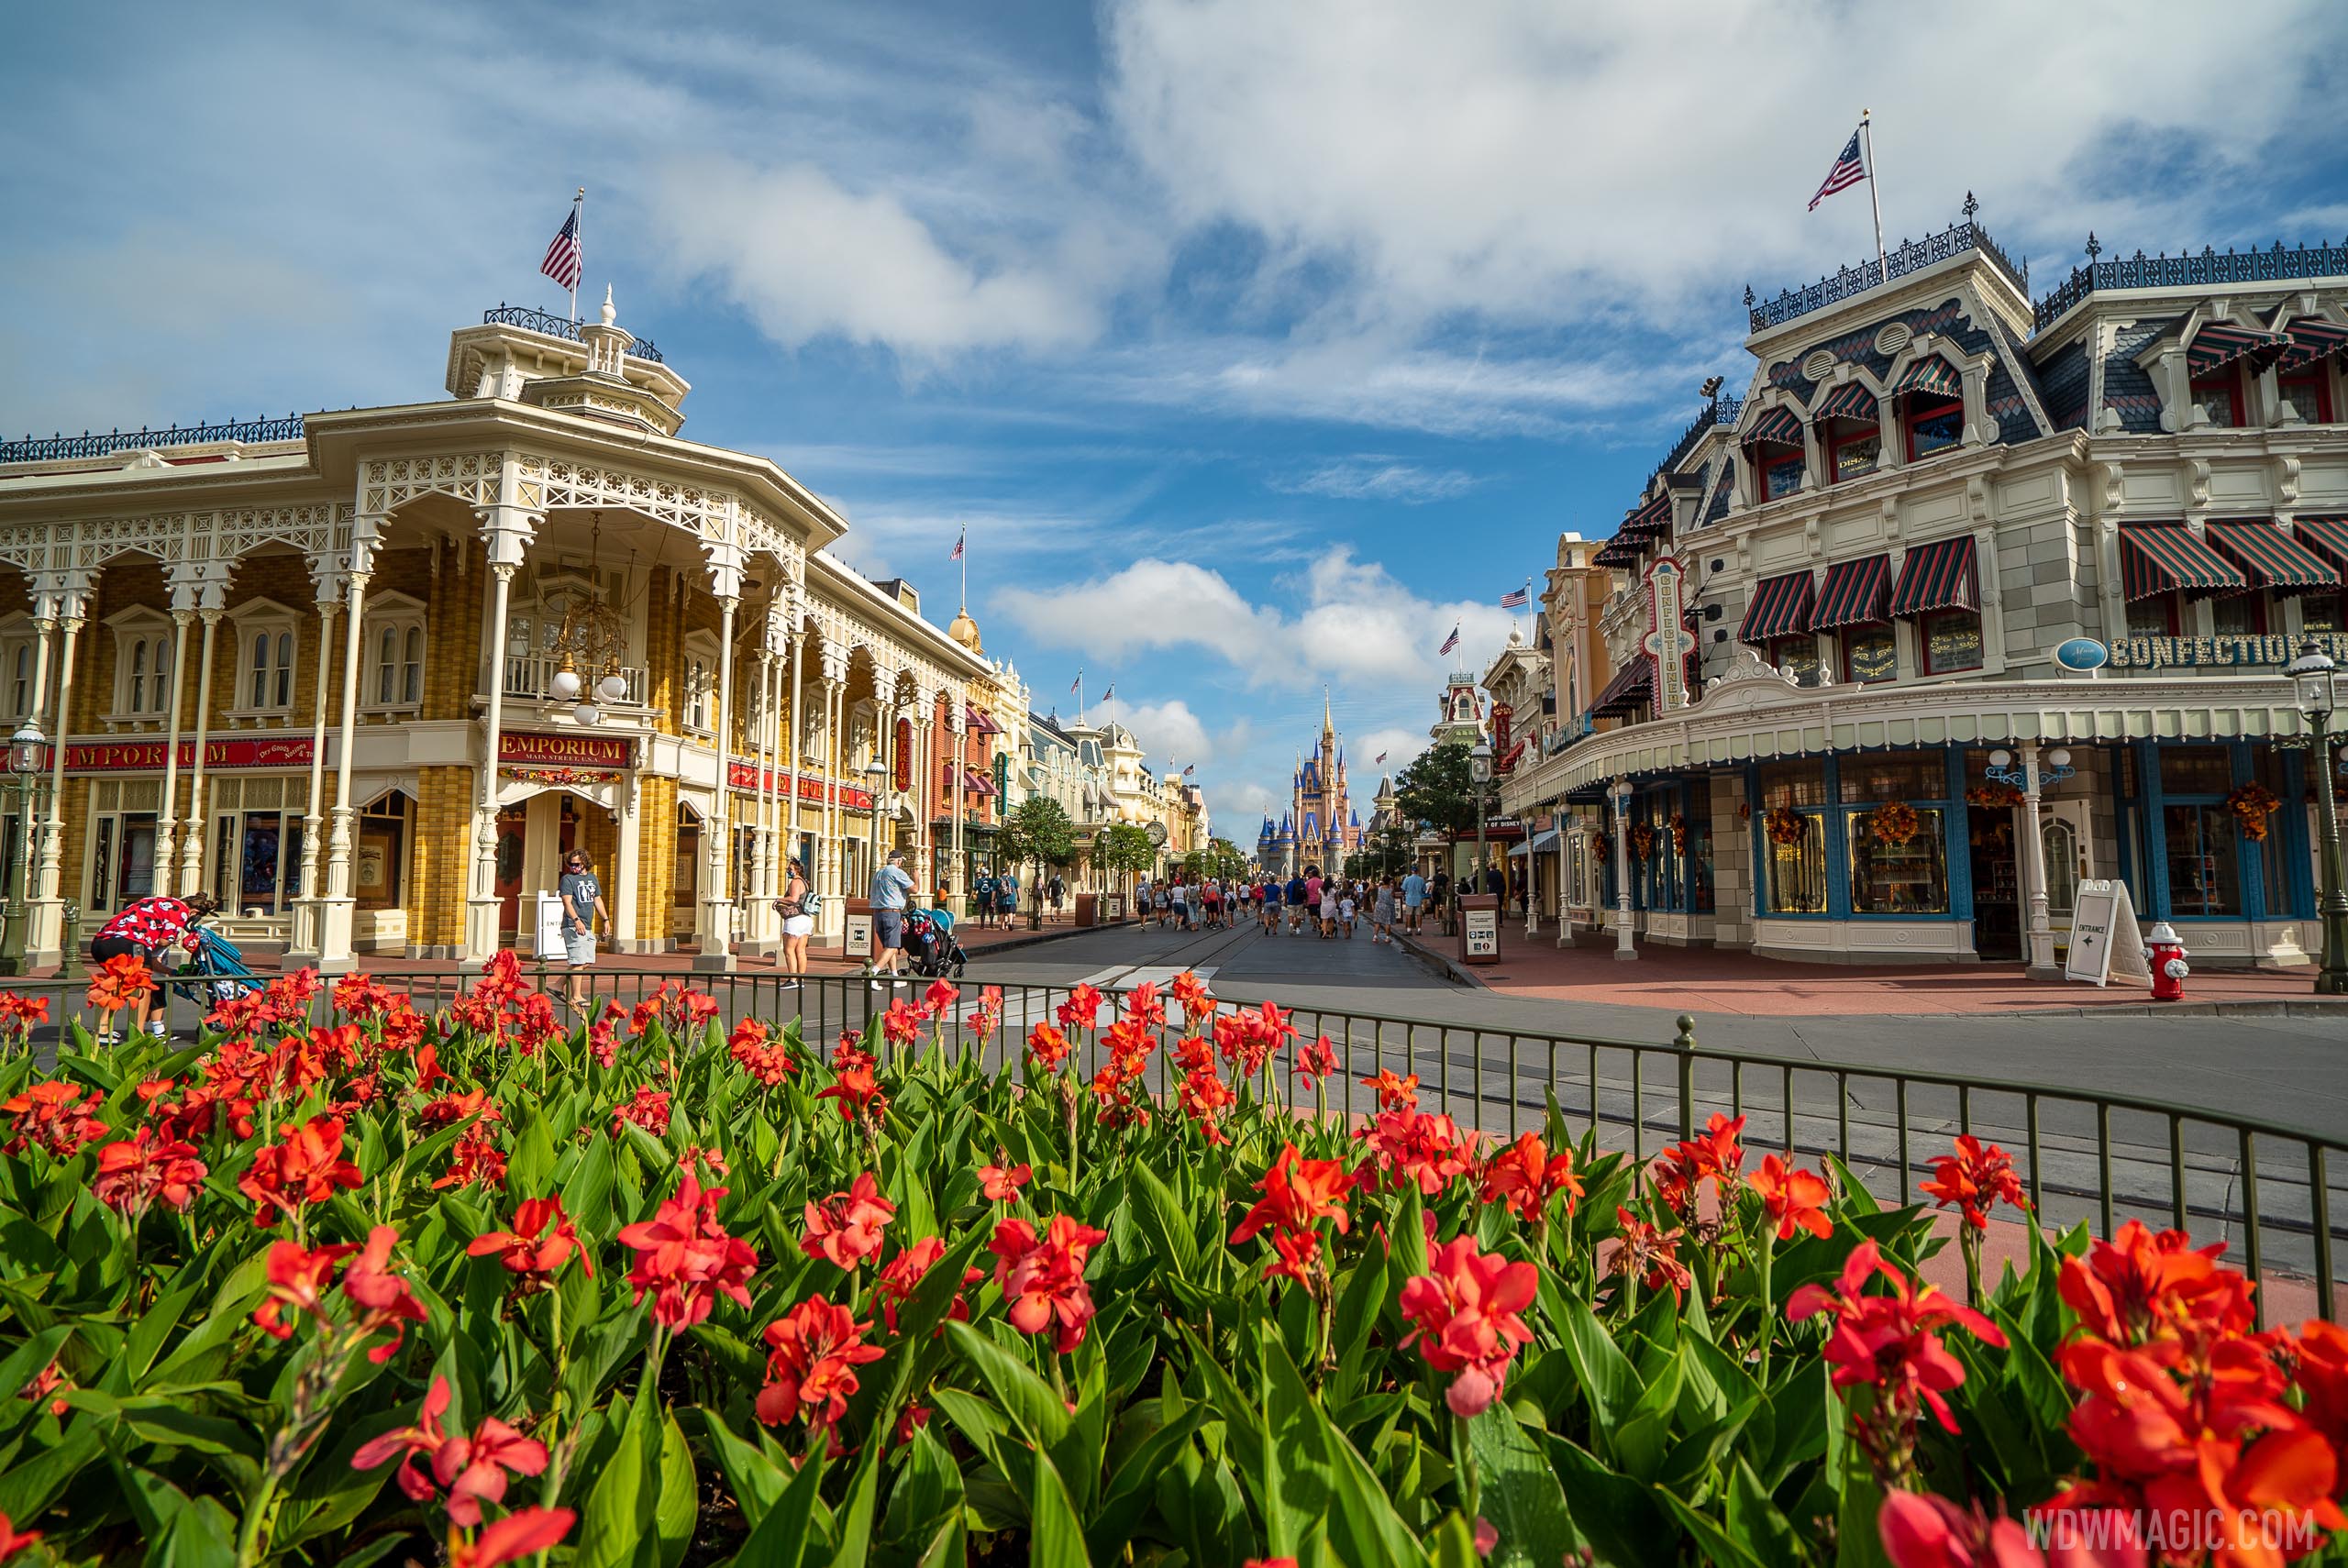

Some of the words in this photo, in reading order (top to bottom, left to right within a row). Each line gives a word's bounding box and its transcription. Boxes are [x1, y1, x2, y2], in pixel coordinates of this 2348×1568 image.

[259, 748, 271, 758] Dry
[271, 745, 290, 753] Goods
[284, 743, 306, 759] Notions
[500, 735, 622, 759] EMPORIUM
[899, 725, 908, 784] EMPORIUM
[2077, 923, 2106, 934] ENTRANCE
